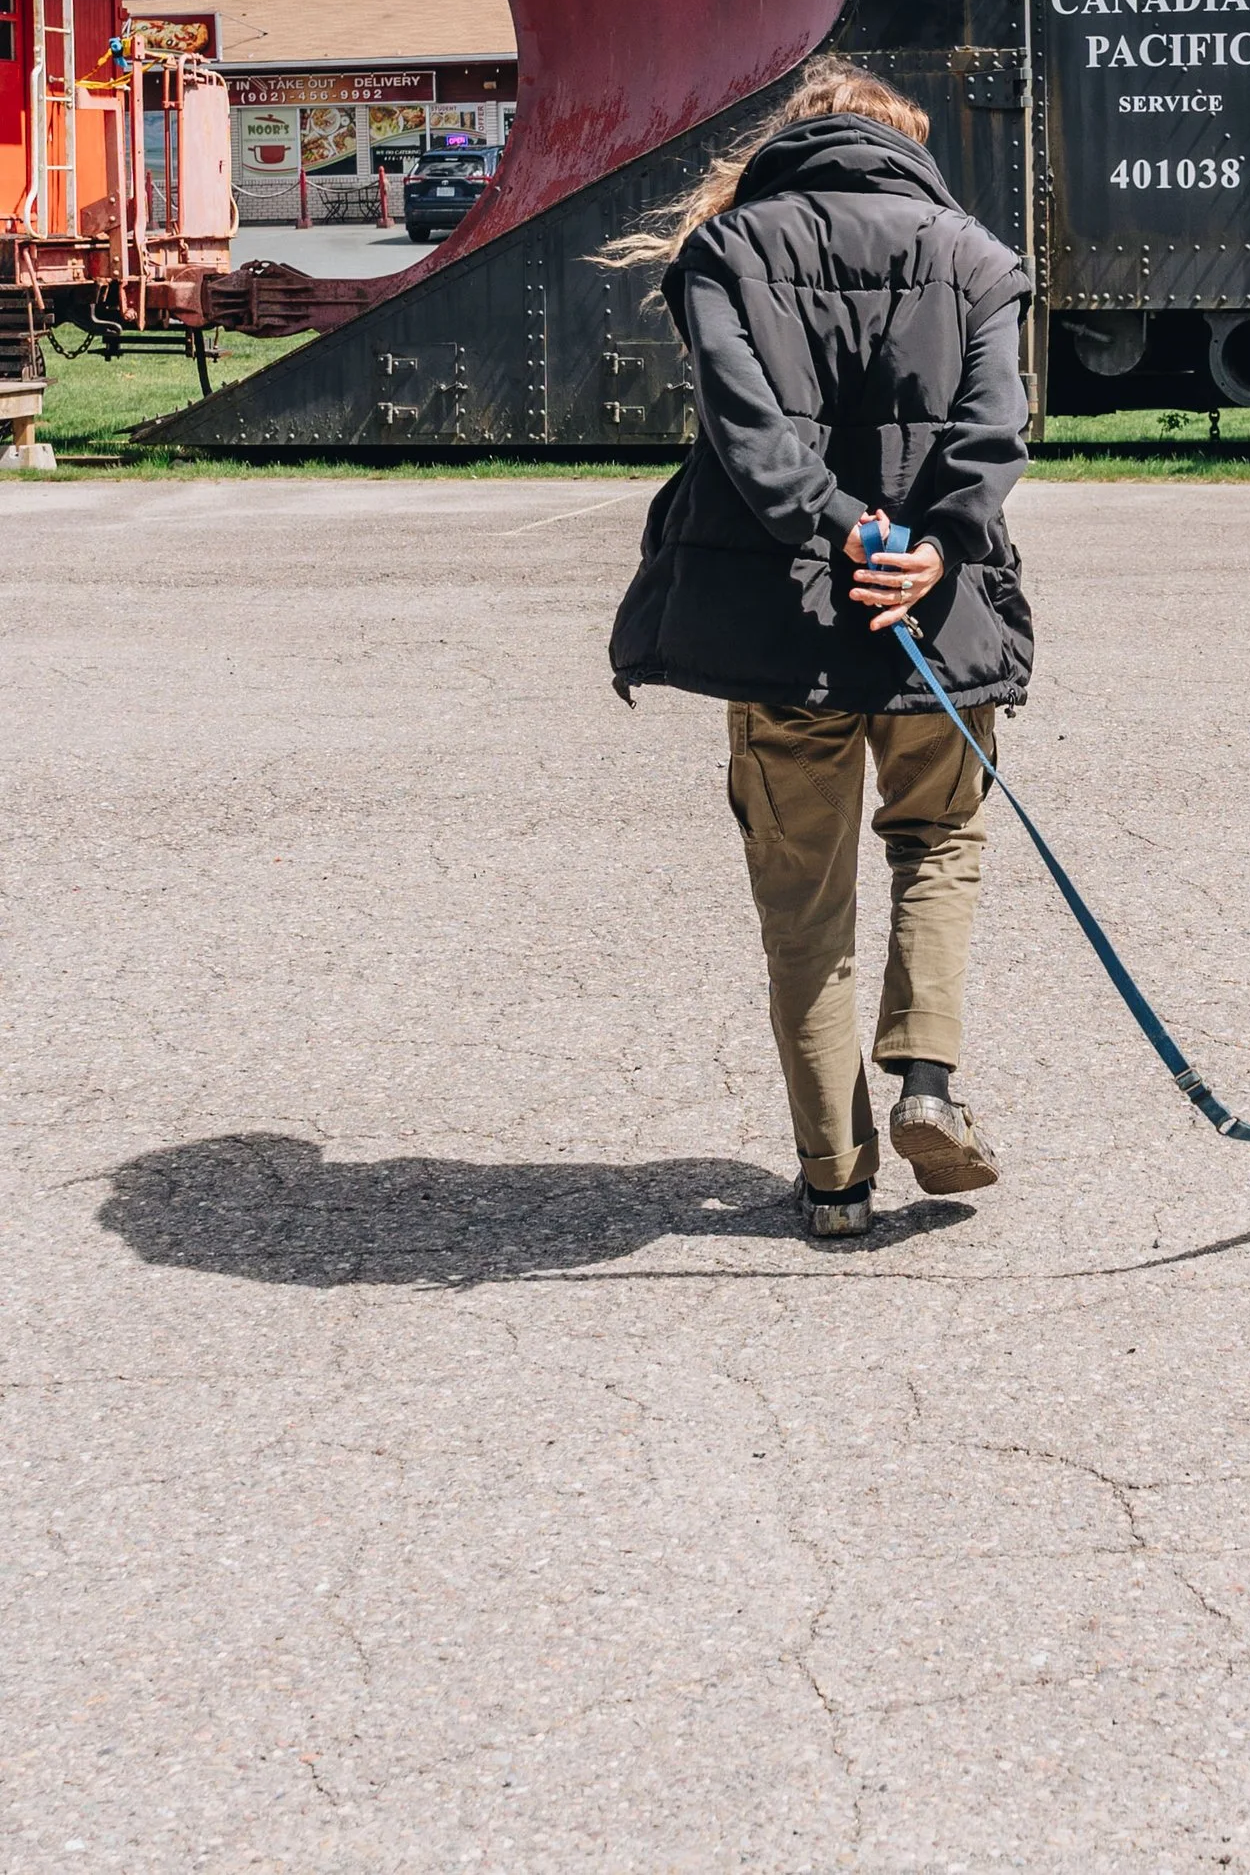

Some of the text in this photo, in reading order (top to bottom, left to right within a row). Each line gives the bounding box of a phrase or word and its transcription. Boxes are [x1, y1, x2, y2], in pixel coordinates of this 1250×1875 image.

[236, 81, 250, 91] IN
[268, 79, 304, 90] TAKE
[308, 78, 336, 88] OUT
[354, 76, 420, 87] DELIVERY
[1119, 95, 1223, 113] SERVICE
[247, 124, 290, 135] NOOR'S
[448, 136, 466, 145] OPEN
[1110, 158, 1241, 189] 401038
